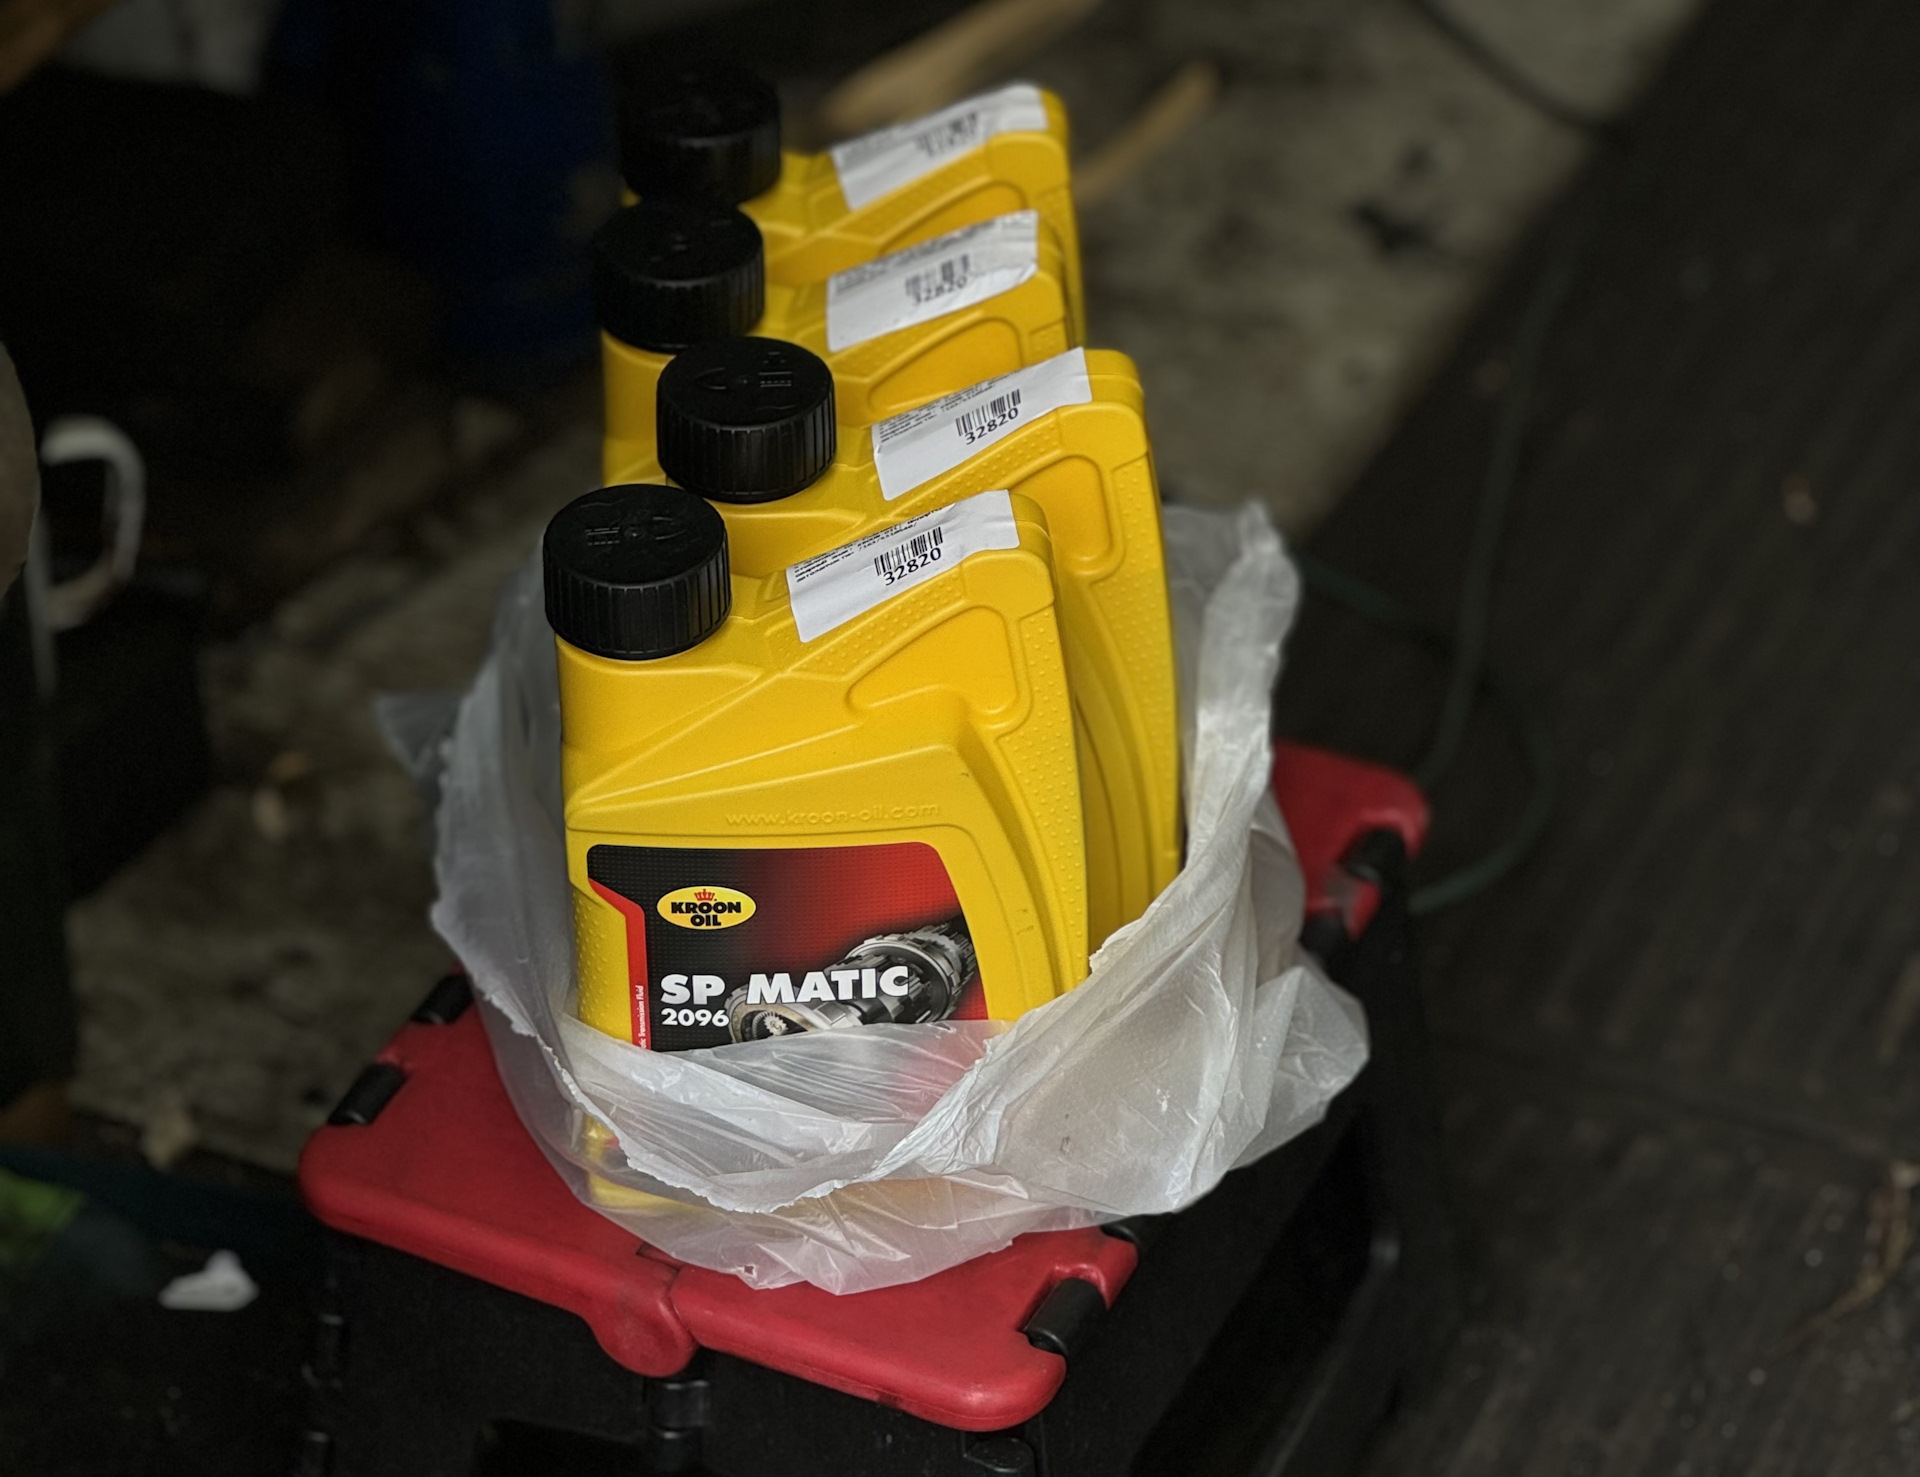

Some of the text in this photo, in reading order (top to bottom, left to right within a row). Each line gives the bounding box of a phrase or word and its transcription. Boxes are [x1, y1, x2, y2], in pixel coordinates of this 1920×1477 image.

[964, 407, 1019, 445] 32820
[883, 547, 942, 586] 32820
[725, 804, 939, 826] www.kroon-oil.com
[671, 901, 742, 914] KROON
[690, 914, 722, 927] OIL
[660, 965, 909, 1005] SP MATIC
[661, 1008, 729, 1027] 2096
